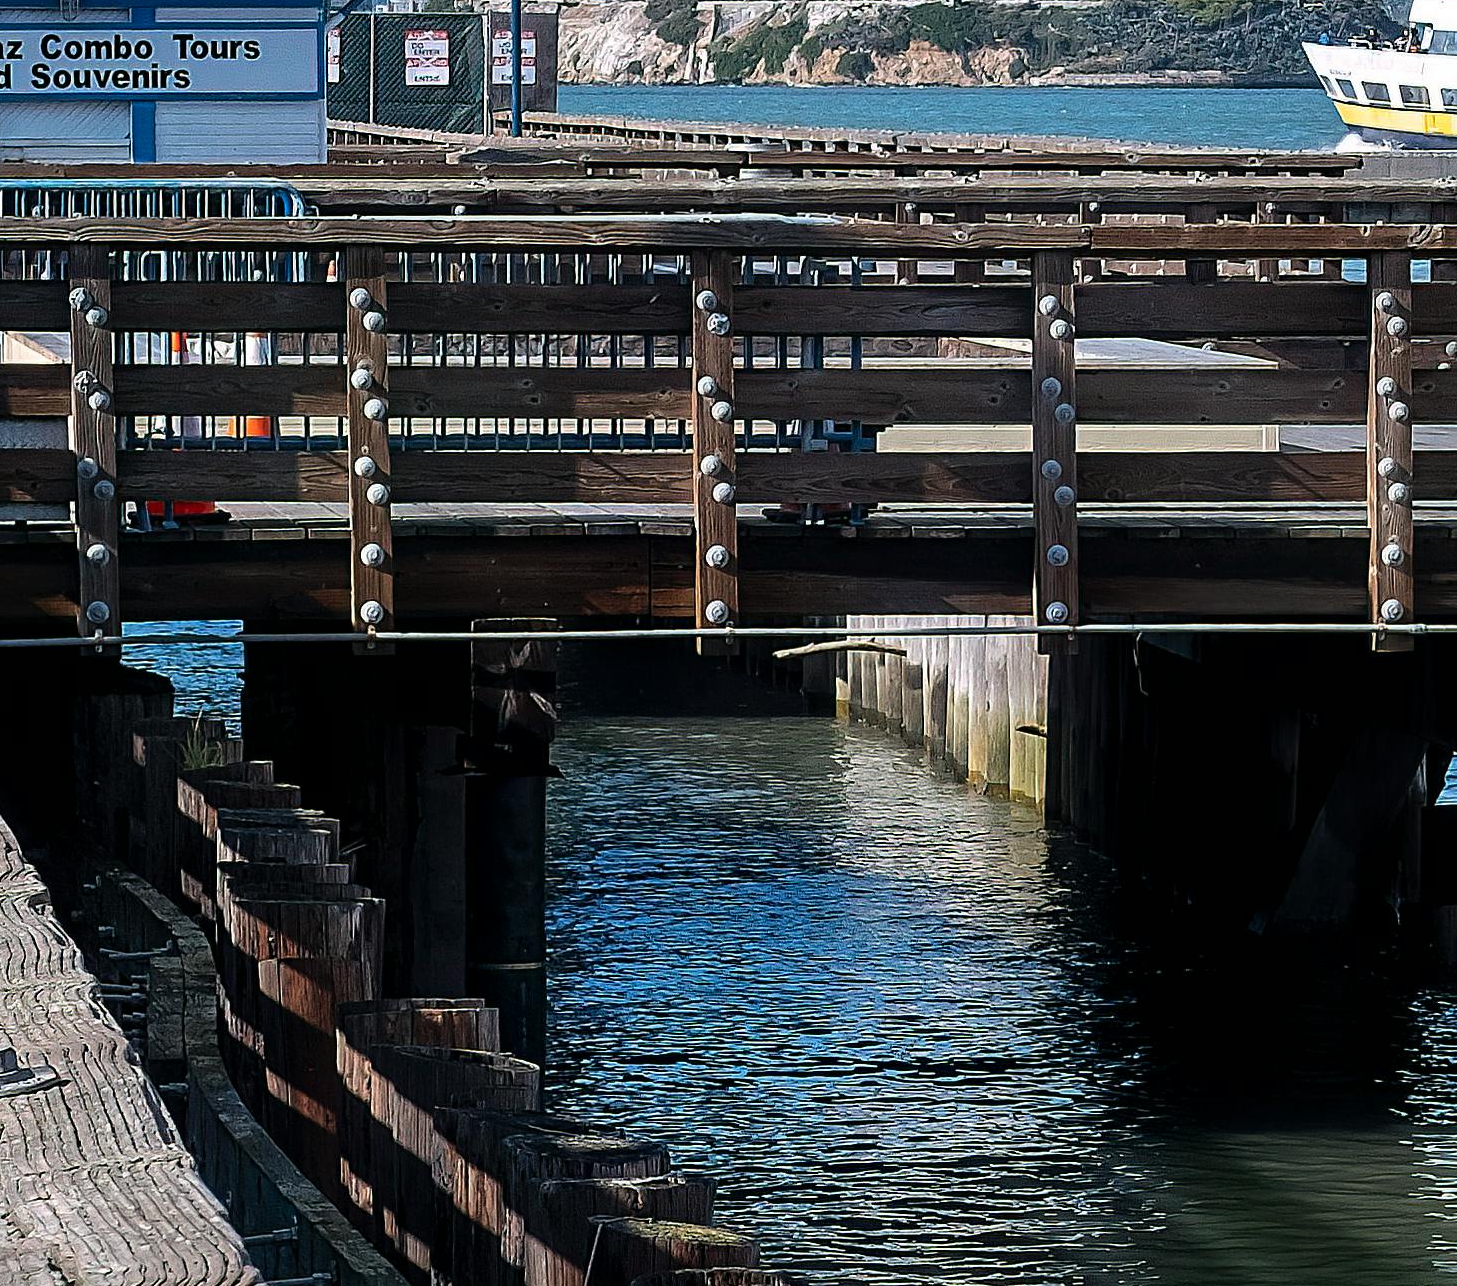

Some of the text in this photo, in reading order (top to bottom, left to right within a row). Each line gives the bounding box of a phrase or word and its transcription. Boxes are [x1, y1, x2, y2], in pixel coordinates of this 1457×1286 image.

[40, 33, 153, 60] Combo
[172, 33, 261, 60] Tours
[30, 63, 191, 90] Souvenirs
